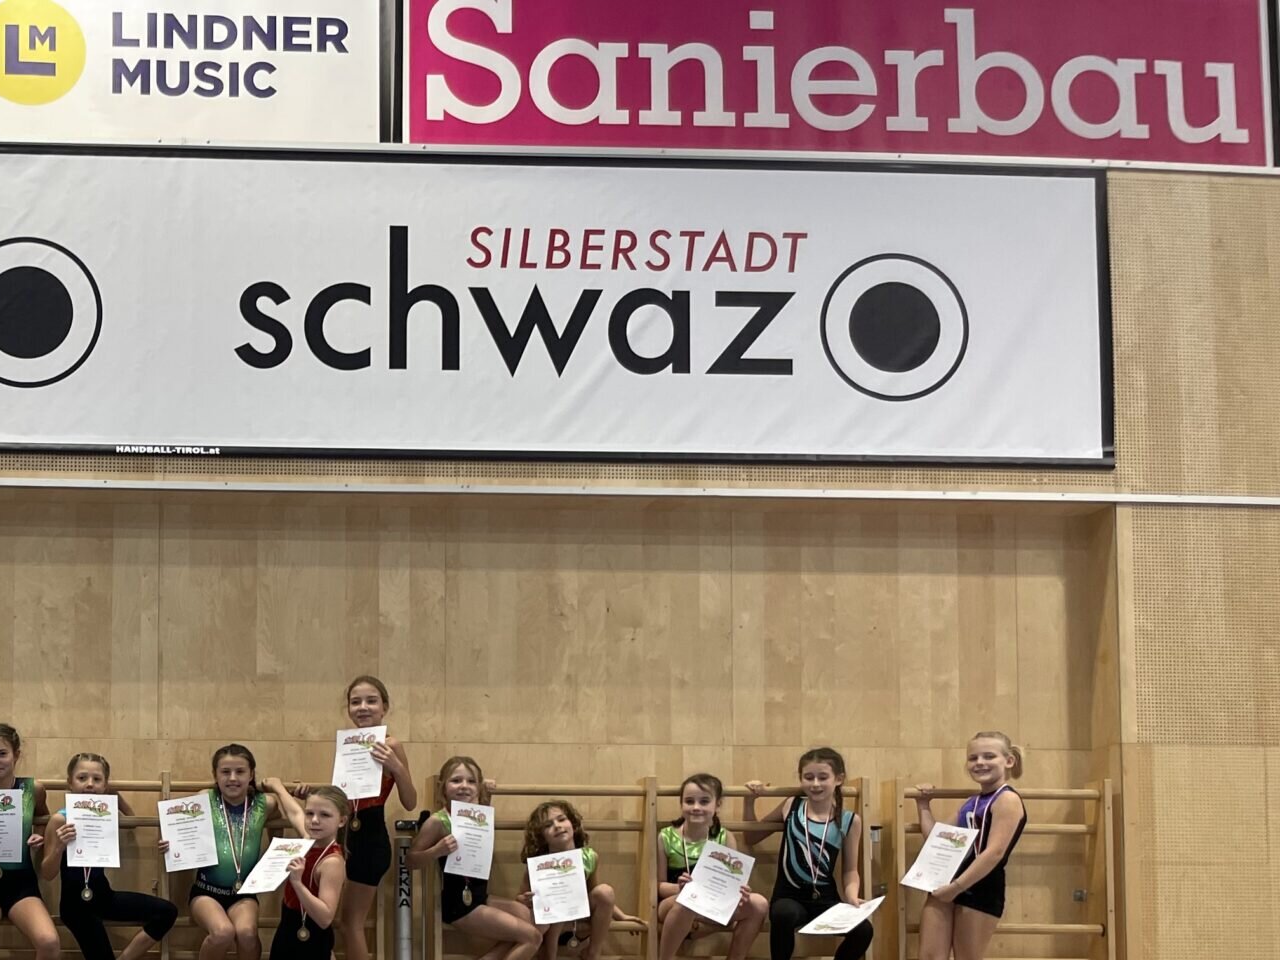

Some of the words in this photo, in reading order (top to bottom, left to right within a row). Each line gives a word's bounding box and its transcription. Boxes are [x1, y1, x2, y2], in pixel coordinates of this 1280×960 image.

[112, 11, 350, 54] LINDNER
[112, 58, 278, 99] MUSIC
[424, 0, 1250, 144] Sanierbau
[466, 226, 809, 275] SILBERSTADT
[234, 225, 795, 379] schwaz
[115, 445, 221, 455] HANDBALL-TIROL.at
